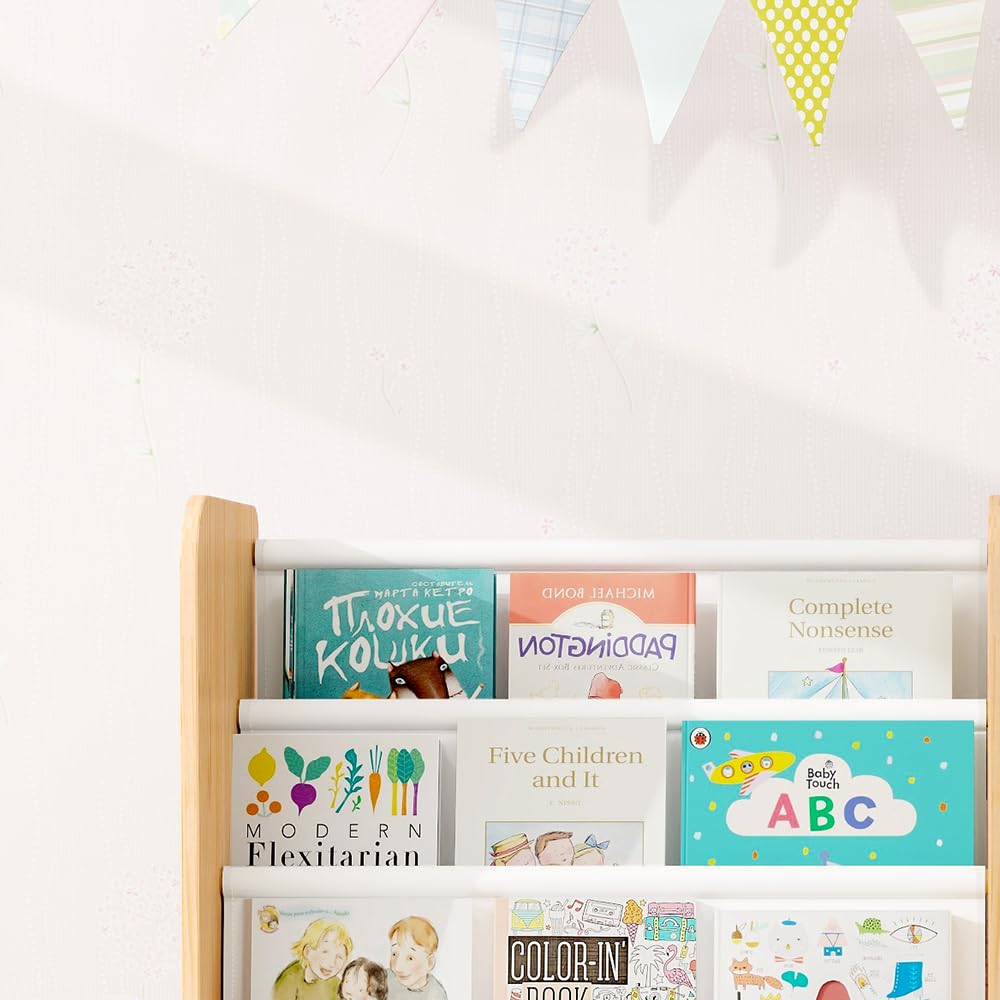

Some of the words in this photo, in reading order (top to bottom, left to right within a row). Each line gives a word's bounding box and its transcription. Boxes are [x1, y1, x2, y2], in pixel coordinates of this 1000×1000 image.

[788, 597, 893, 620] Complete
[788, 621, 894, 639] Nonsense
[488, 746, 536, 764] Five
[542, 746, 644, 765] Children
[532, 770, 576, 788] and
[583, 771, 600, 788] It
[807, 767, 837, 780] Baby
[805, 778, 840, 789] Touch
[246, 823, 422, 839] MODERN
[247, 841, 419, 866] Flexitarian
